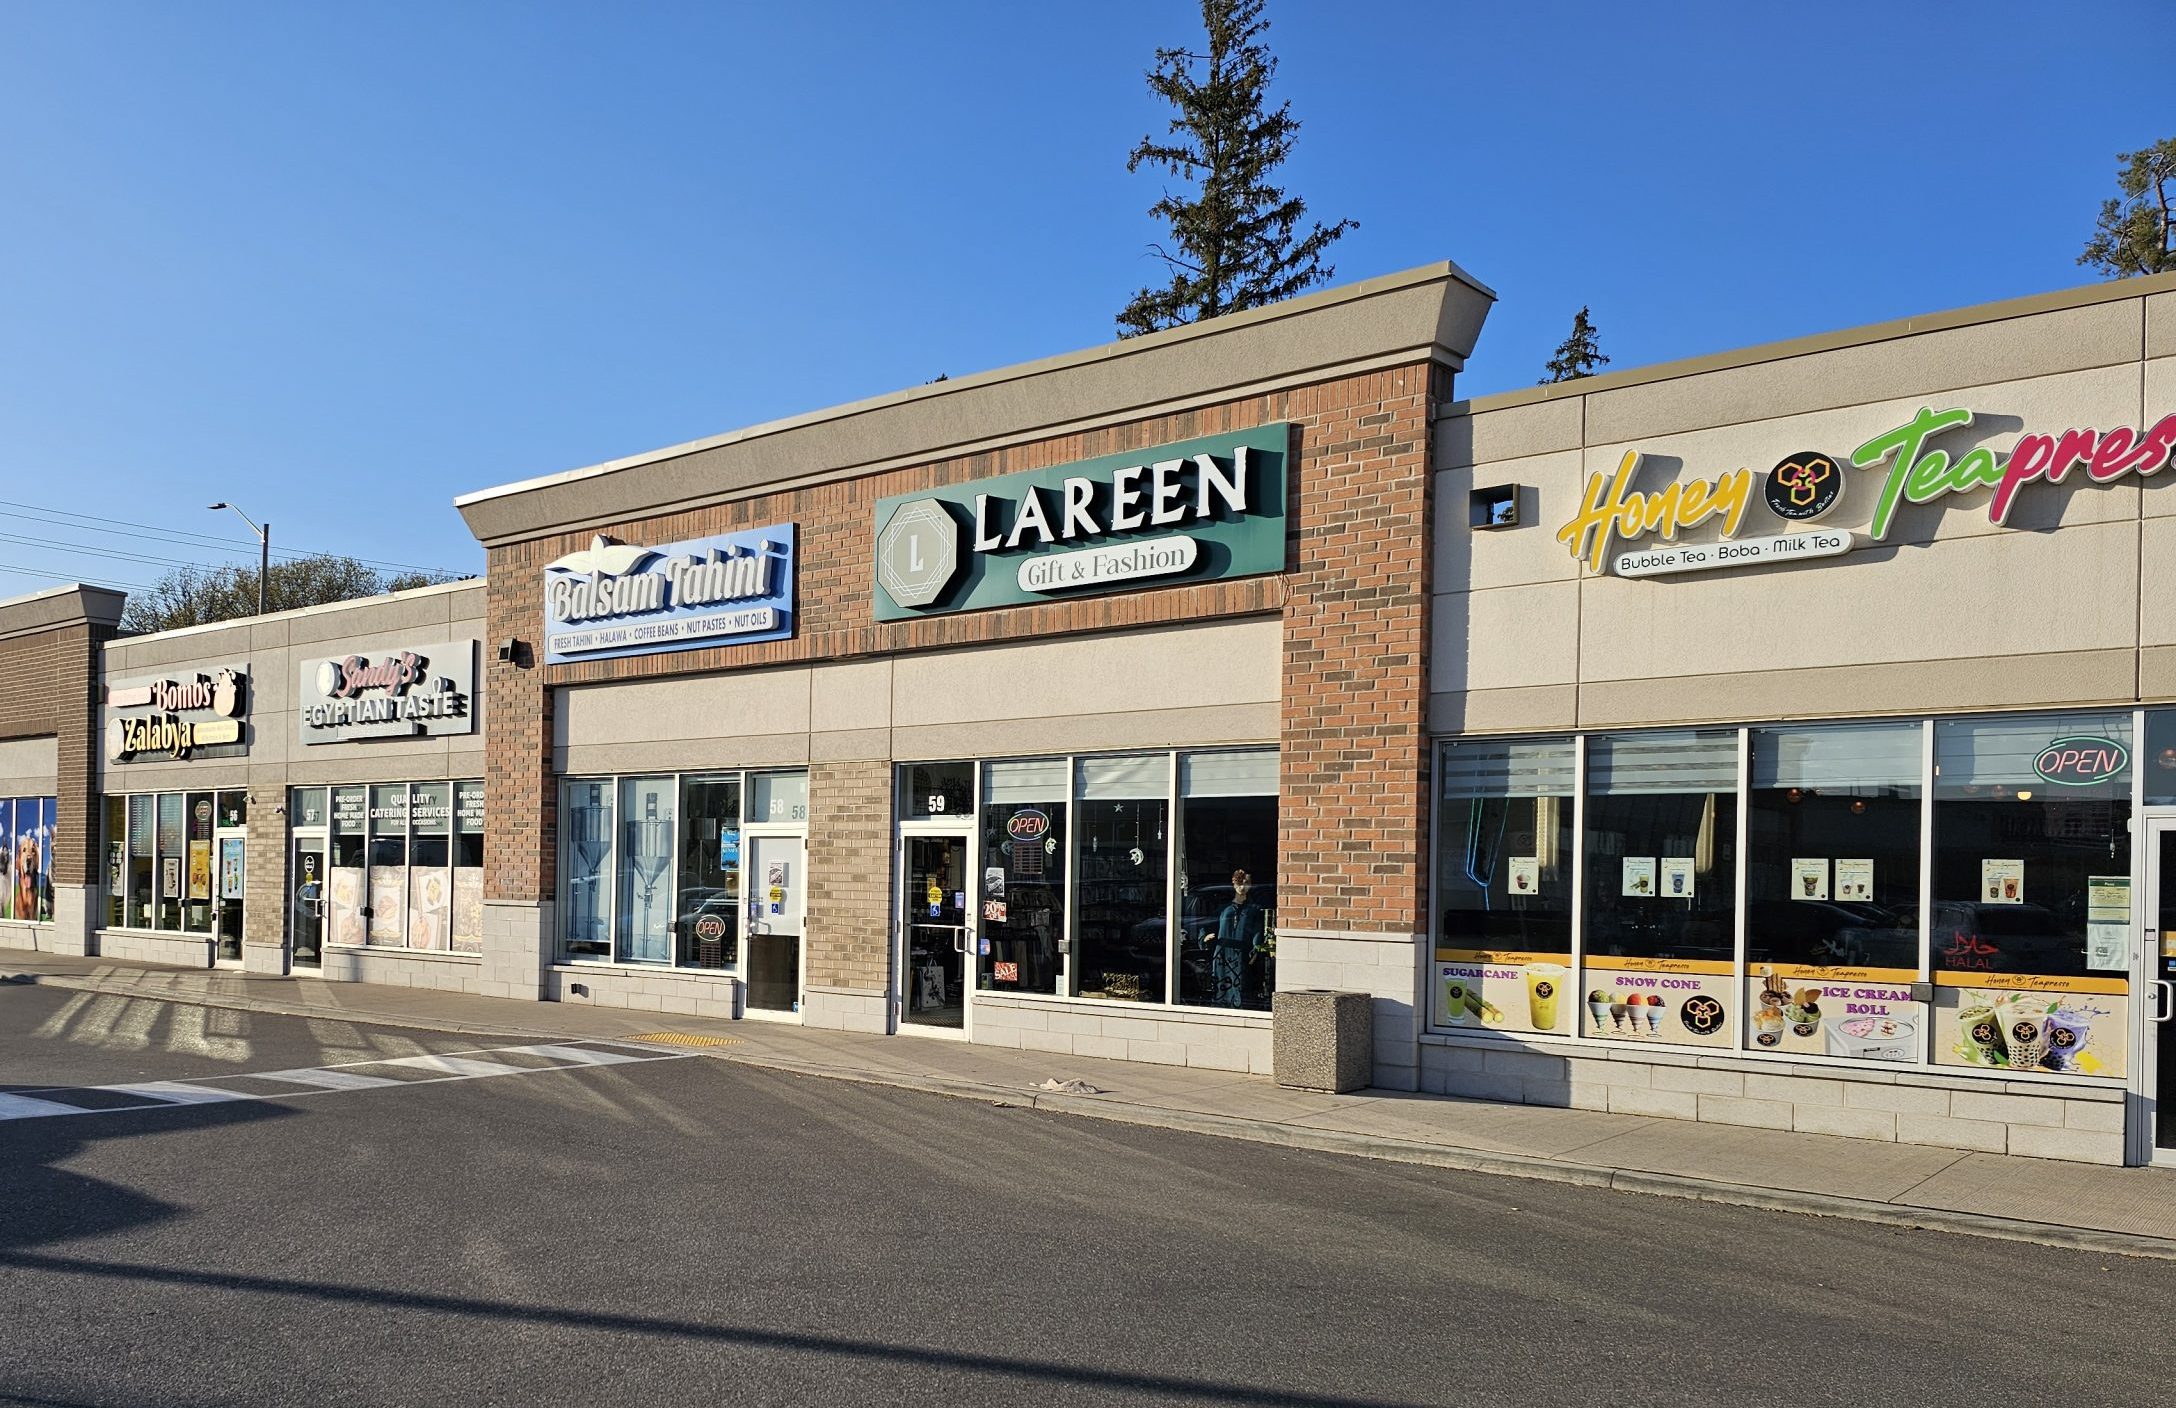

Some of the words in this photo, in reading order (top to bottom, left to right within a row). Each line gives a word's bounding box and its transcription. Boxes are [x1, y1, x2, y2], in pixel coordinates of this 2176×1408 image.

[1850, 406, 2176, 541] Teapres
[973, 446, 1249, 552] LAREEN
[1557, 450, 1756, 575] Honey
[1621, 552, 1675, 570] Bubble
[1680, 550, 1706, 563] Tea
[1719, 546, 1760, 559] Boba
[1774, 538, 1806, 552] Milk
[1812, 535, 1840, 548] Tea
[1028, 559, 1065, 586] Gift
[1071, 558, 1085, 579] &
[1093, 545, 1185, 579] Fashion
[549, 570, 664, 622] Balsam
[666, 539, 772, 607] Tahini
[554, 635, 572, 649] FRESH
[573, 634, 593, 648] TAHINI
[601, 630, 627, 643] HALAWA
[634, 626, 656, 640] COFFEE
[657, 623, 679, 637] BEANS
[687, 621, 700, 634] NUT
[703, 618, 726, 631] PASTES
[735, 614, 749, 628] NUT
[751, 612, 767, 625] OILS
[153, 672, 211, 711] Bombs
[303, 697, 388, 726] EGYPTIAN
[395, 691, 454, 719] TASTE
[125, 712, 192, 758] Zalabya
[2039, 750, 2118, 773] OPEN
[459, 791, 484, 799] PRE-ORD
[928, 795, 945, 812] 59
[306, 809, 315, 821] 57
[370, 807, 407, 818] CATERING
[412, 806, 450, 818] SERVICES
[770, 799, 784, 815] 58
[1009, 817, 1045, 834] OPEN
[698, 921, 723, 935] OPEN
[995, 963, 1017, 980] SALE
[1945, 957, 1993, 969] HALAL
[1442, 967, 1518, 980] SUGARCANE
[1985, 975, 2010, 986] Honey
[2028, 976, 2070, 988] Teapresso
[1615, 977, 1658, 988] SNOW
[1661, 979, 1701, 990] CONE
[1822, 986, 1851, 998] ICE
[1846, 1003, 1890, 1016] ROLL
